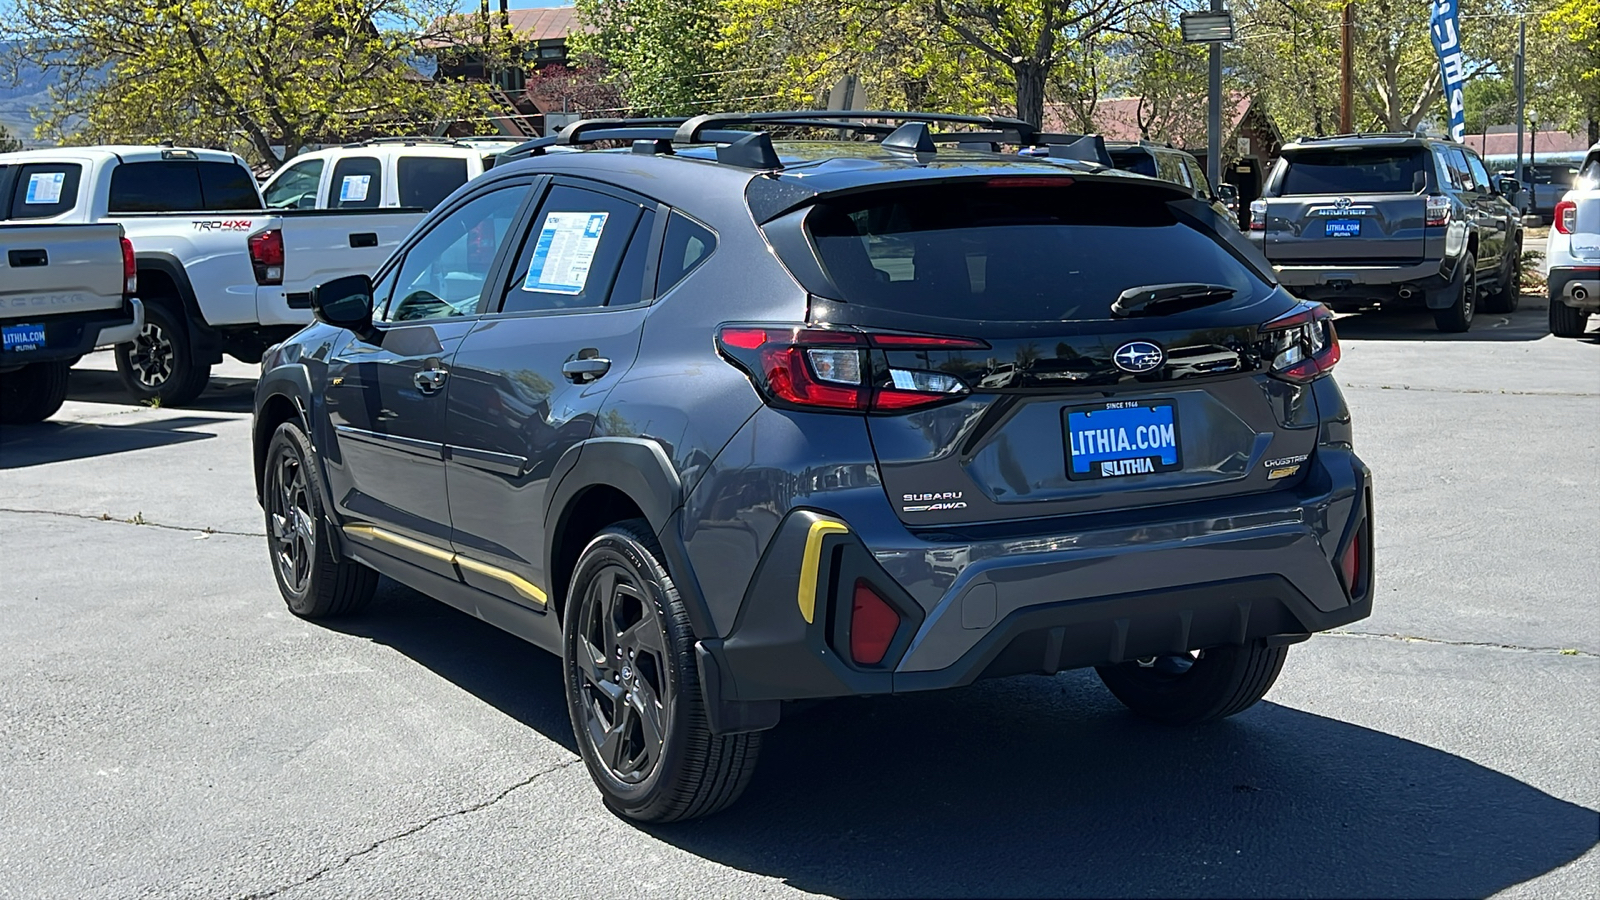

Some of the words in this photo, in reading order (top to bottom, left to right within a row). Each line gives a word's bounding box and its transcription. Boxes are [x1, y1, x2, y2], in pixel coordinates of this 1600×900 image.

[192, 220, 222, 231] TRD
[1326, 223, 1360, 231] LITHIA.COM
[3, 331, 45, 344] LITHIA.COM
[1106, 402, 1124, 410] SINCE
[1069, 423, 1176, 456] LITHIA.COM
[1264, 454, 1308, 467] CROSSTREK
[1113, 458, 1155, 476] LITHIA
[903, 491, 962, 501] SUBARU
[928, 502, 967, 511] AWD
